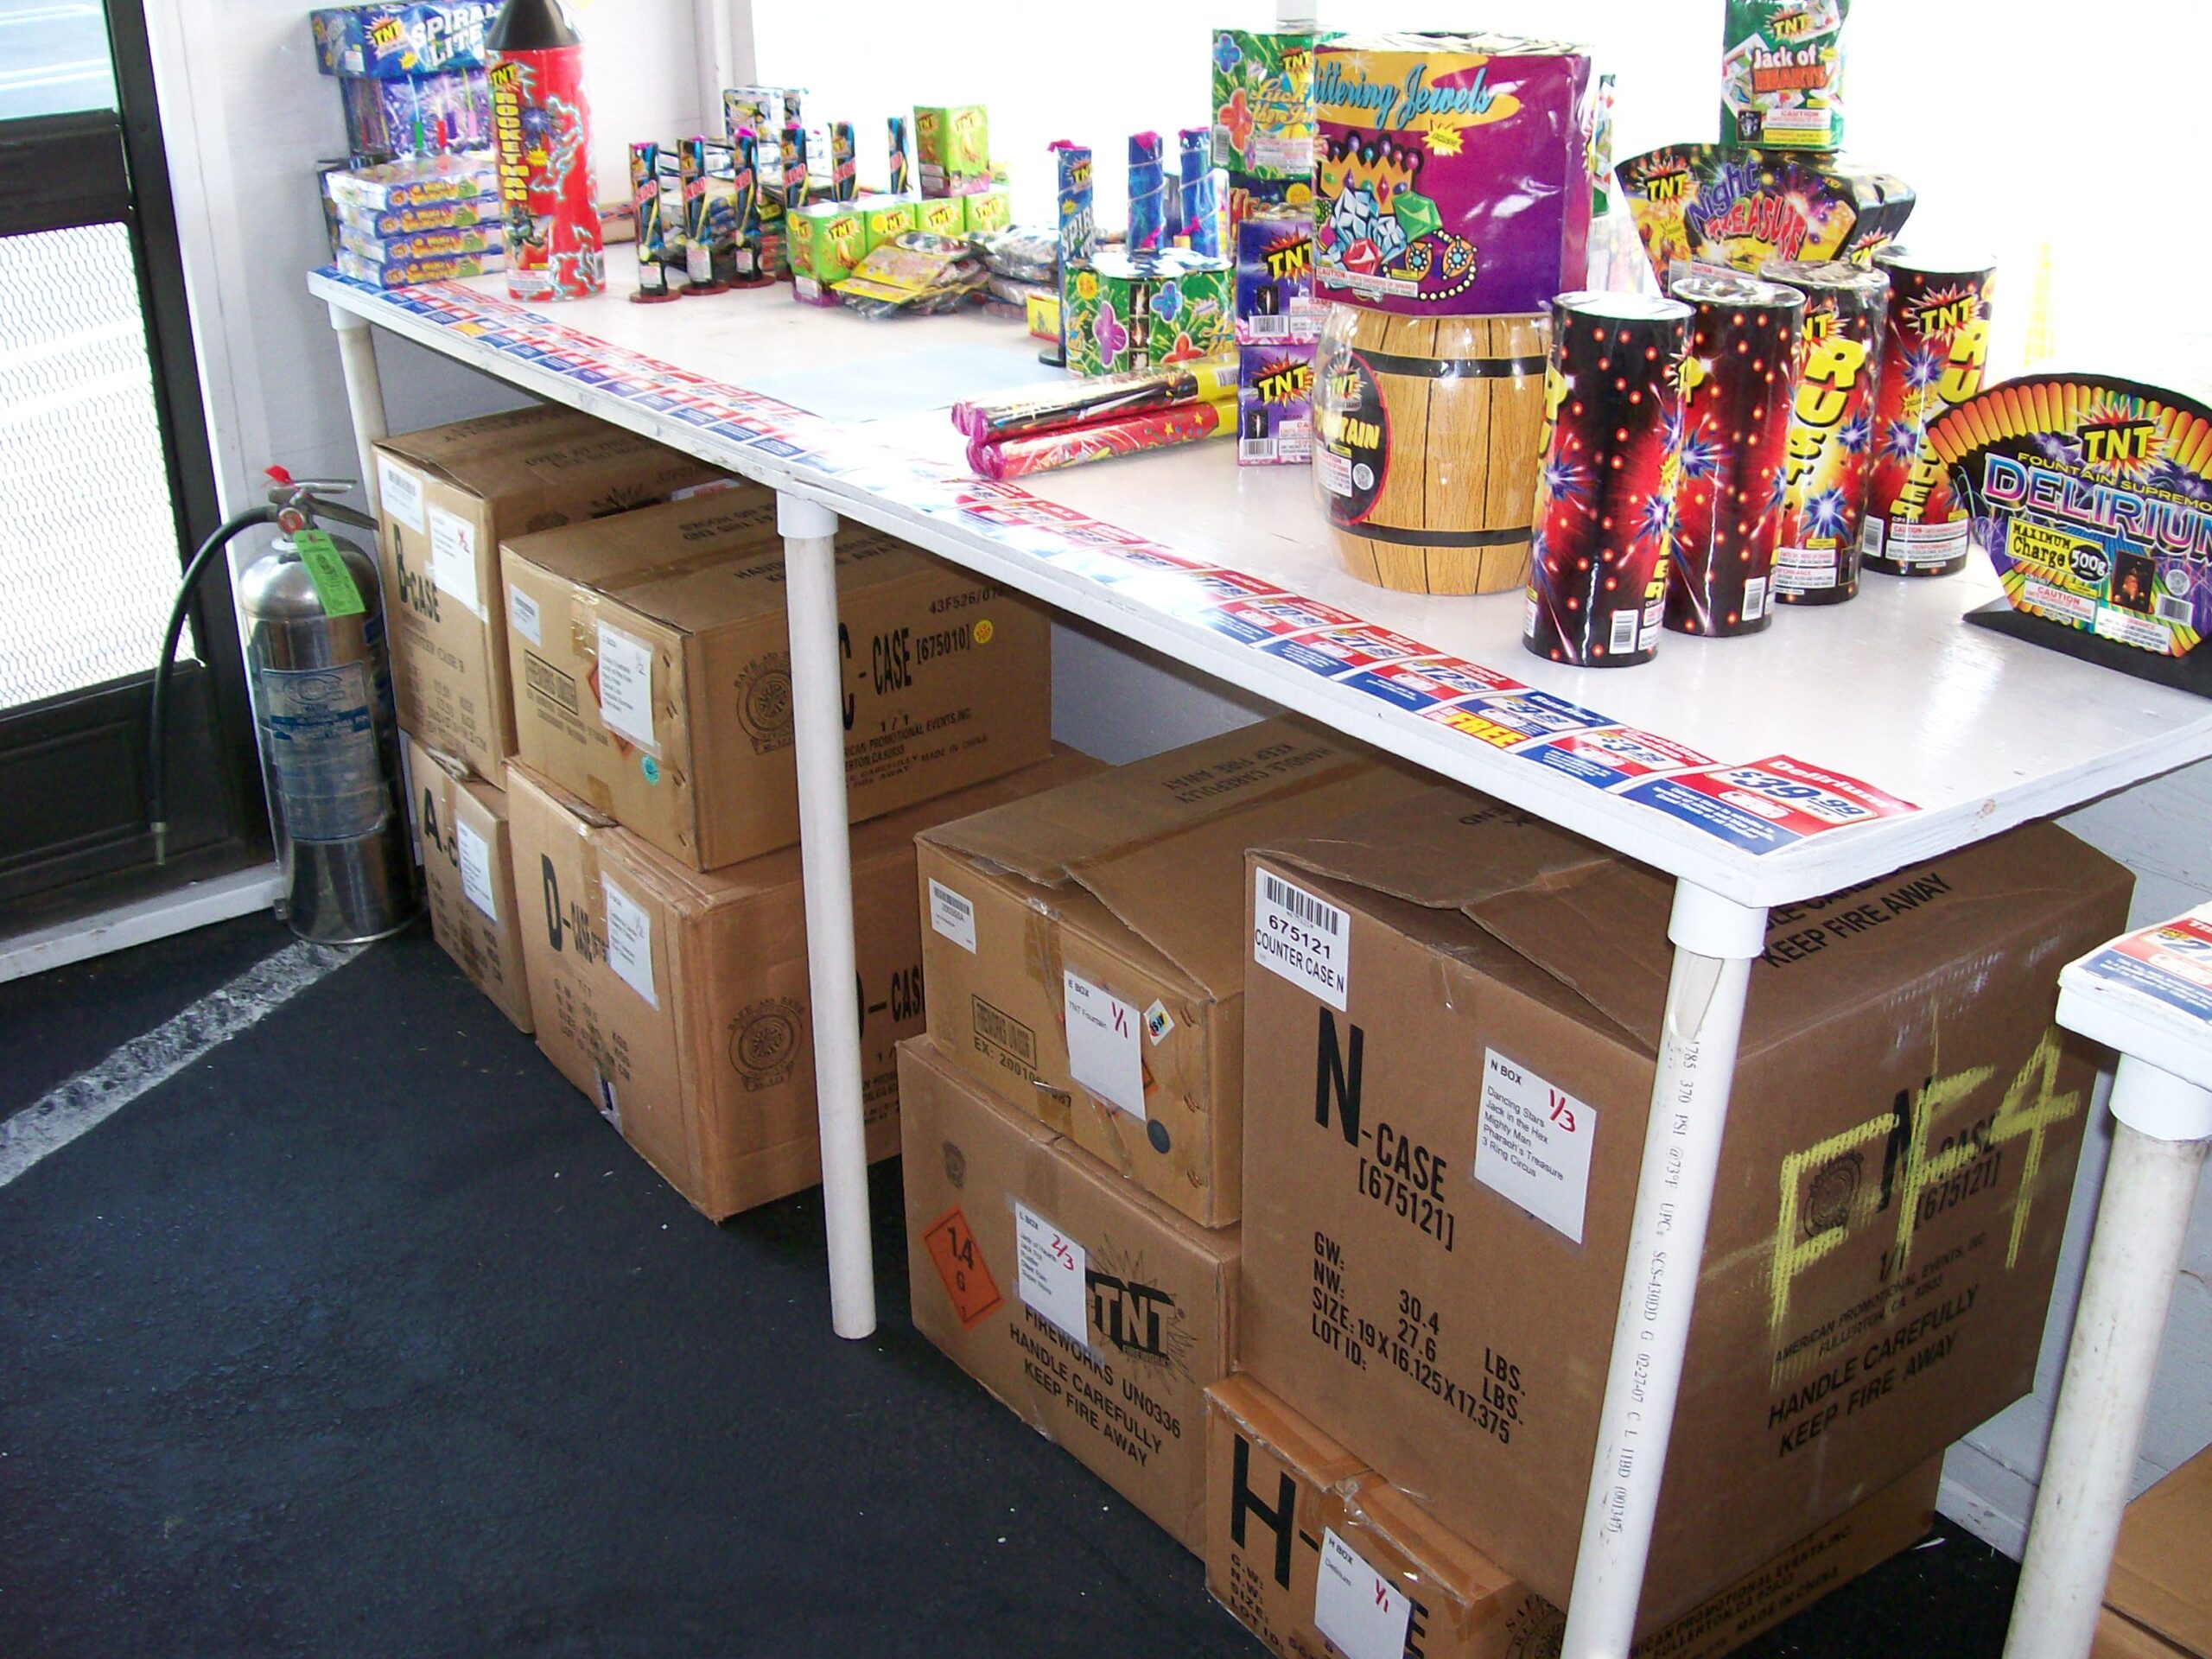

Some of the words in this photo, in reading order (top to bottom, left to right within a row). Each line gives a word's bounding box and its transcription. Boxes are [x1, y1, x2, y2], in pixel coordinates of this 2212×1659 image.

[373, 19, 402, 43] TNT
[430, 23, 486, 67] LITE
[1774, 13, 1809, 37] TNT
[492, 63, 516, 85] TNT
[1284, 52, 1313, 69] TNT
[1753, 46, 1793, 68] Jack
[1796, 44, 1818, 66] of
[1313, 60, 1400, 130] littering
[1396, 63, 1495, 130] Jewels
[1751, 65, 1827, 93] HEARTS
[495, 90, 531, 201] ROCKETMAN
[1647, 172, 1688, 201] TNT
[1688, 157, 1762, 232] Night
[830, 219, 854, 239] TNT
[929, 208, 953, 227] TNT
[1268, 237, 1313, 278] TNT
[1801, 309, 1834, 342] NT
[1920, 301, 1974, 335] TNT
[1257, 365, 1311, 404] TNT
[1331, 374, 1357, 397] TNT
[2083, 424, 2155, 465] TNT
[2017, 452, 2118, 486] FOUNTAIN
[2012, 522, 2072, 550] MAXIMUM
[2012, 536, 2067, 568] Charge
[2069, 548, 2107, 576] 500g
[2037, 586, 2082, 605] CAUTION
[915, 623, 972, 665] [675010]
[1442, 711, 1530, 748] FREE
[1729, 770, 1868, 817] $39.99
[1768, 760, 1904, 812] Delirium
[1268, 913, 1332, 961] 675121
[1761, 926, 1829, 969] KEEP
[1823, 902, 1885, 939] FIRE
[1884, 871, 1953, 917] AWAY
[1254, 928, 1304, 972] COUNTER
[1305, 955, 1335, 989] CASE
[1336, 974, 1344, 995] N
[1068, 978, 1073, 988] E
[1074, 982, 1090, 997] BOX
[1491, 1058, 1498, 1071] N
[1499, 1065, 1522, 1086] BOX
[1314, 1005, 1447, 1204] N-CASE
[1485, 1099, 1505, 1117] Jack
[1506, 1111, 1515, 1122] in
[1516, 1118, 1529, 1132] the
[1487, 1084, 1521, 1115] Dancing
[1522, 1107, 1546, 1128] Stars
[1549, 1087, 1576, 1134] 1/3
[1484, 1109, 1512, 1135] Mighty
[1513, 1128, 1532, 1147] Man
[1481, 1135, 1488, 1147] 3
[1489, 1140, 1509, 1163] Ring
[1526, 1150, 1564, 1181] Treasure
[1357, 1156, 1455, 1253] [675121]
[1313, 1230, 1345, 1271] GW:
[1313, 1257, 1345, 1300] NW:
[1090, 1283, 1173, 1355] TNT
[1312, 1313, 1342, 1351] LOT
[1344, 1337, 1367, 1372] ID:
[1398, 1288, 1440, 1336] 30.4
[1484, 1346, 1526, 1397] LBS.
[1768, 1357, 1858, 1429] HANDLE
[1863, 1283, 1980, 1371] CAREFULLY
[1777, 1319, 1836, 1363] AMERICAN
[1009, 1322, 1069, 1382] HANDLE
[1071, 1372, 1162, 1454] CAREFULLY
[1025, 1304, 1114, 1386] FIREWORKS
[1122, 1376, 1181, 1439] UN0336
[1396, 1318, 1437, 1363] 27.6
[1482, 1376, 1524, 1427] LBS.
[1023, 1357, 1062, 1397] KEEP
[1065, 1393, 1099, 1432] FIRE
[1103, 1423, 1149, 1469] AWAY
[1778, 1402, 1839, 1458] KEEP
[1847, 1370, 1896, 1416] FIRE
[1904, 1329, 1961, 1386] AWAY
[1328, 1537, 1337, 1551] H
[1336, 1544, 1354, 1567] BOX
